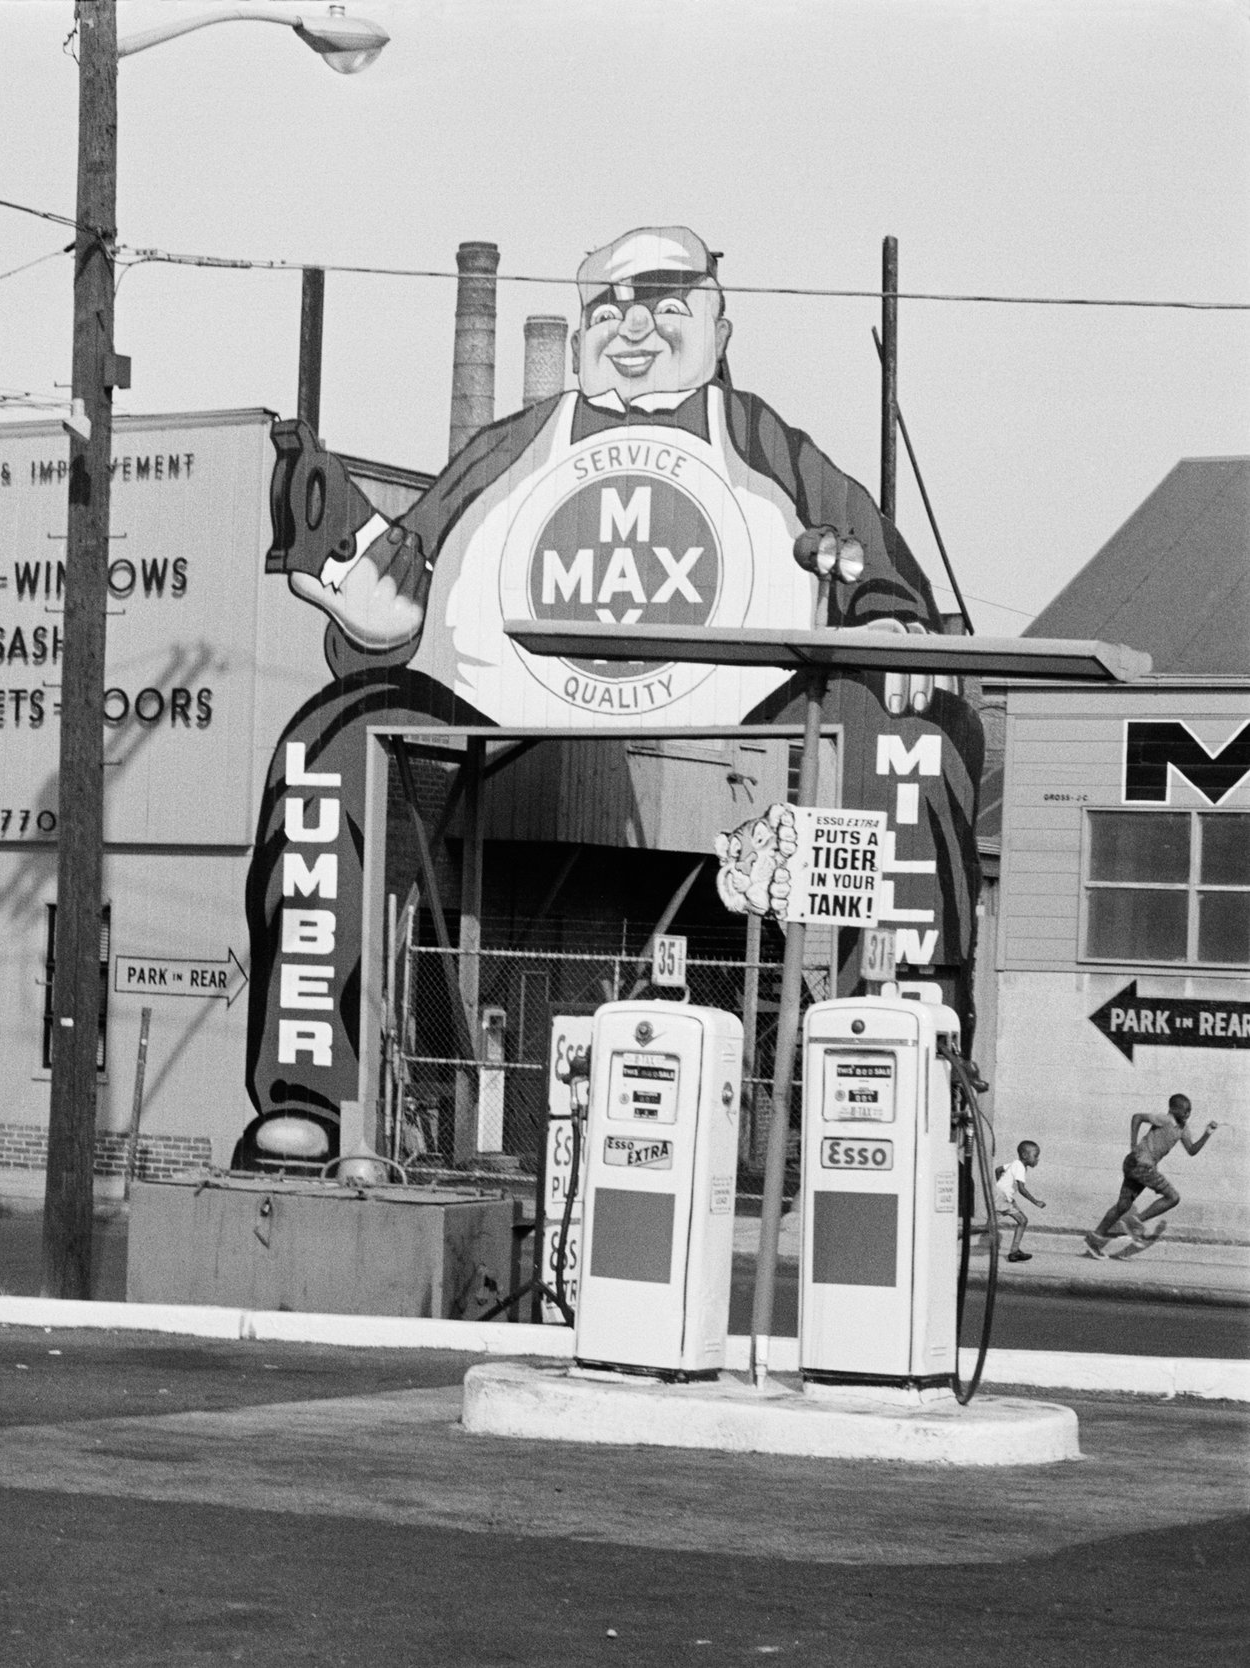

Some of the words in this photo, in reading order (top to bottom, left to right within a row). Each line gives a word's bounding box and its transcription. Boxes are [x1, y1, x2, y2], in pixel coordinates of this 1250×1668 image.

[0, 462, 12, 486] &
[30, 453, 195, 485] IMPVEMENT
[573, 445, 687, 480] SERVICE
[541, 546, 704, 605] MAX
[563, 674, 674, 709] QUALITY
[816, 816, 845, 826] ESSO
[814, 828, 861, 845] PUTS
[867, 831, 879, 846] A
[812, 846, 877, 872] TIGER
[810, 872, 827, 887] IN
[833, 873, 875, 890] YOUR
[277, 741, 342, 1067] LUMBER
[808, 893, 873, 919] TANK!
[127, 966, 168, 985] PARK
[172, 973, 183, 981] IN
[190, 969, 228, 988] REAR
[1110, 1007, 1171, 1035] PARK
[1175, 1017, 1193, 1028] IN
[627, 1140, 669, 1166] EXTRA
